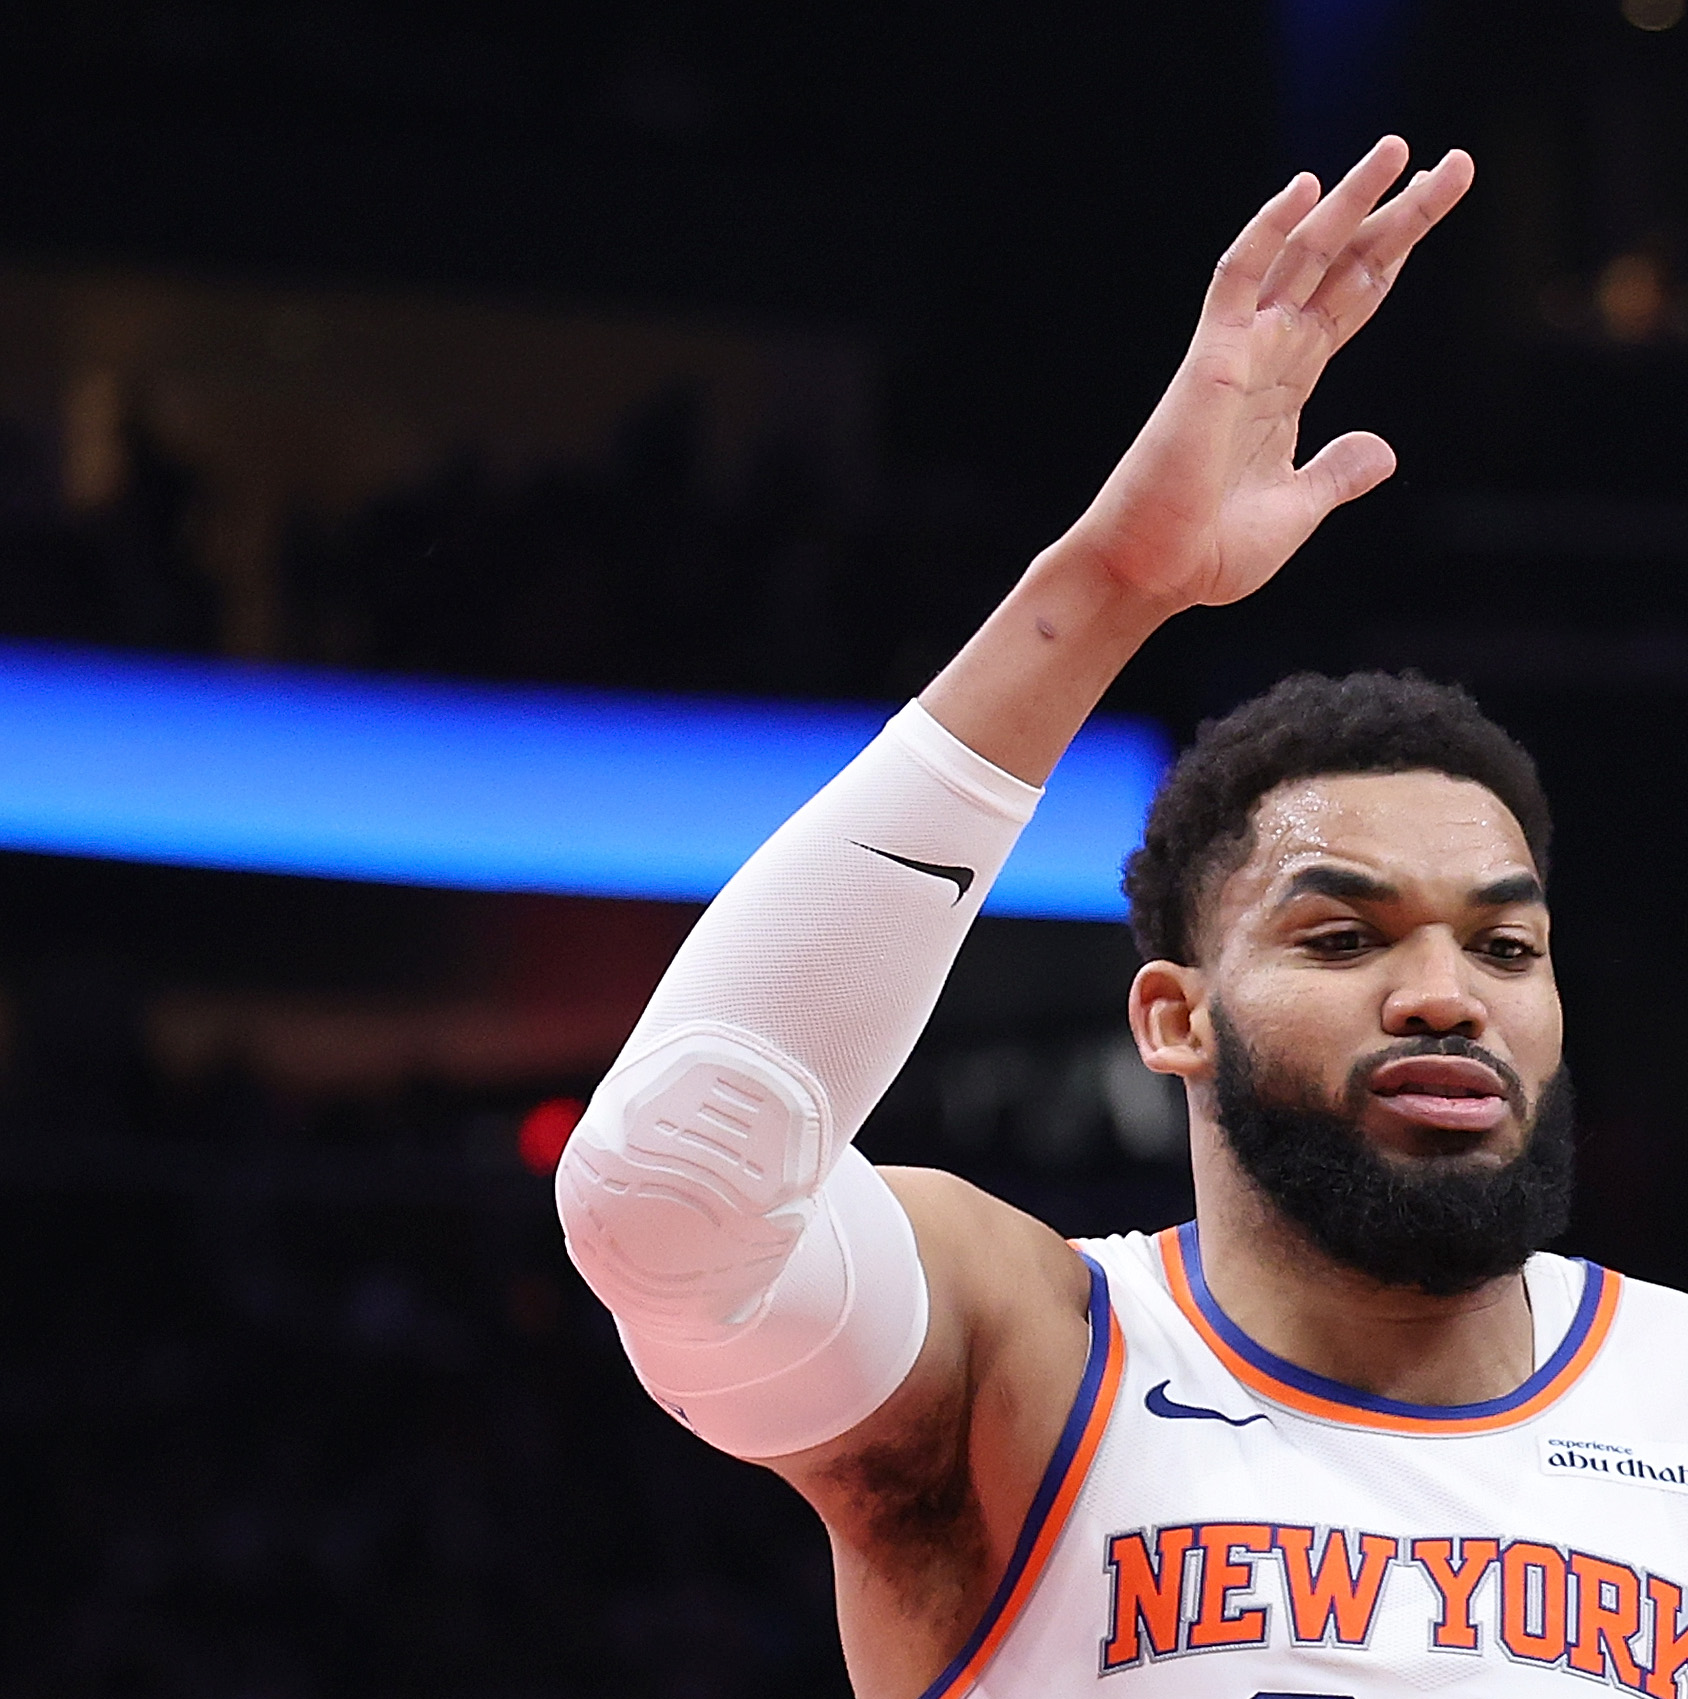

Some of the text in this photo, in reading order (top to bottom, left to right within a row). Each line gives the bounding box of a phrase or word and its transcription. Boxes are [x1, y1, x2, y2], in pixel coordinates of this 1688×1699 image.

[1548, 1438, 1633, 1455] experience
[1548, 1451, 1610, 1473] abu
[1099, 1519, 1400, 1678] NEW
